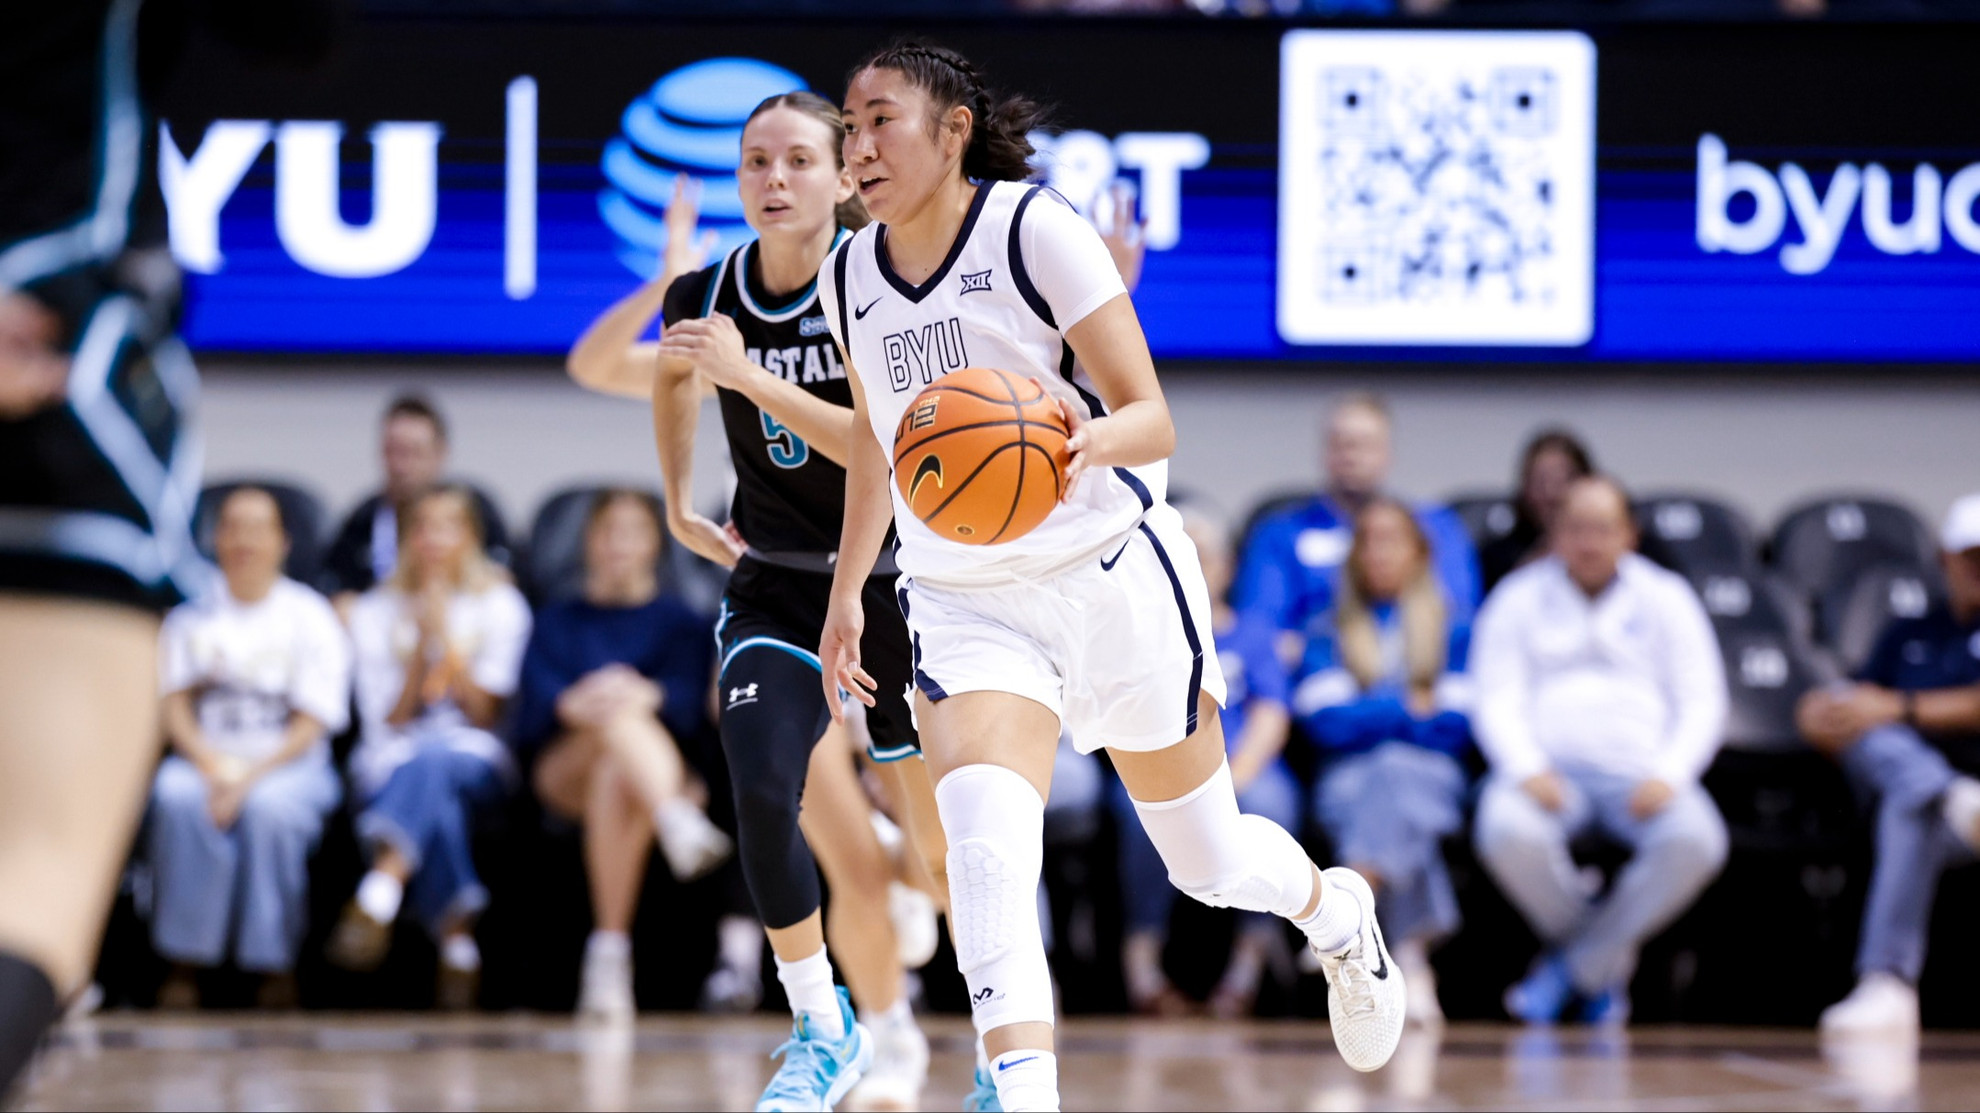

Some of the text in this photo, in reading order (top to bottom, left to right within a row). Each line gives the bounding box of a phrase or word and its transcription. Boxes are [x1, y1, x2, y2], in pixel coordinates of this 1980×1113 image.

[1026, 130, 1211, 251] &T
[883, 317, 968, 393] BYU
[758, 407, 809, 470] 5
